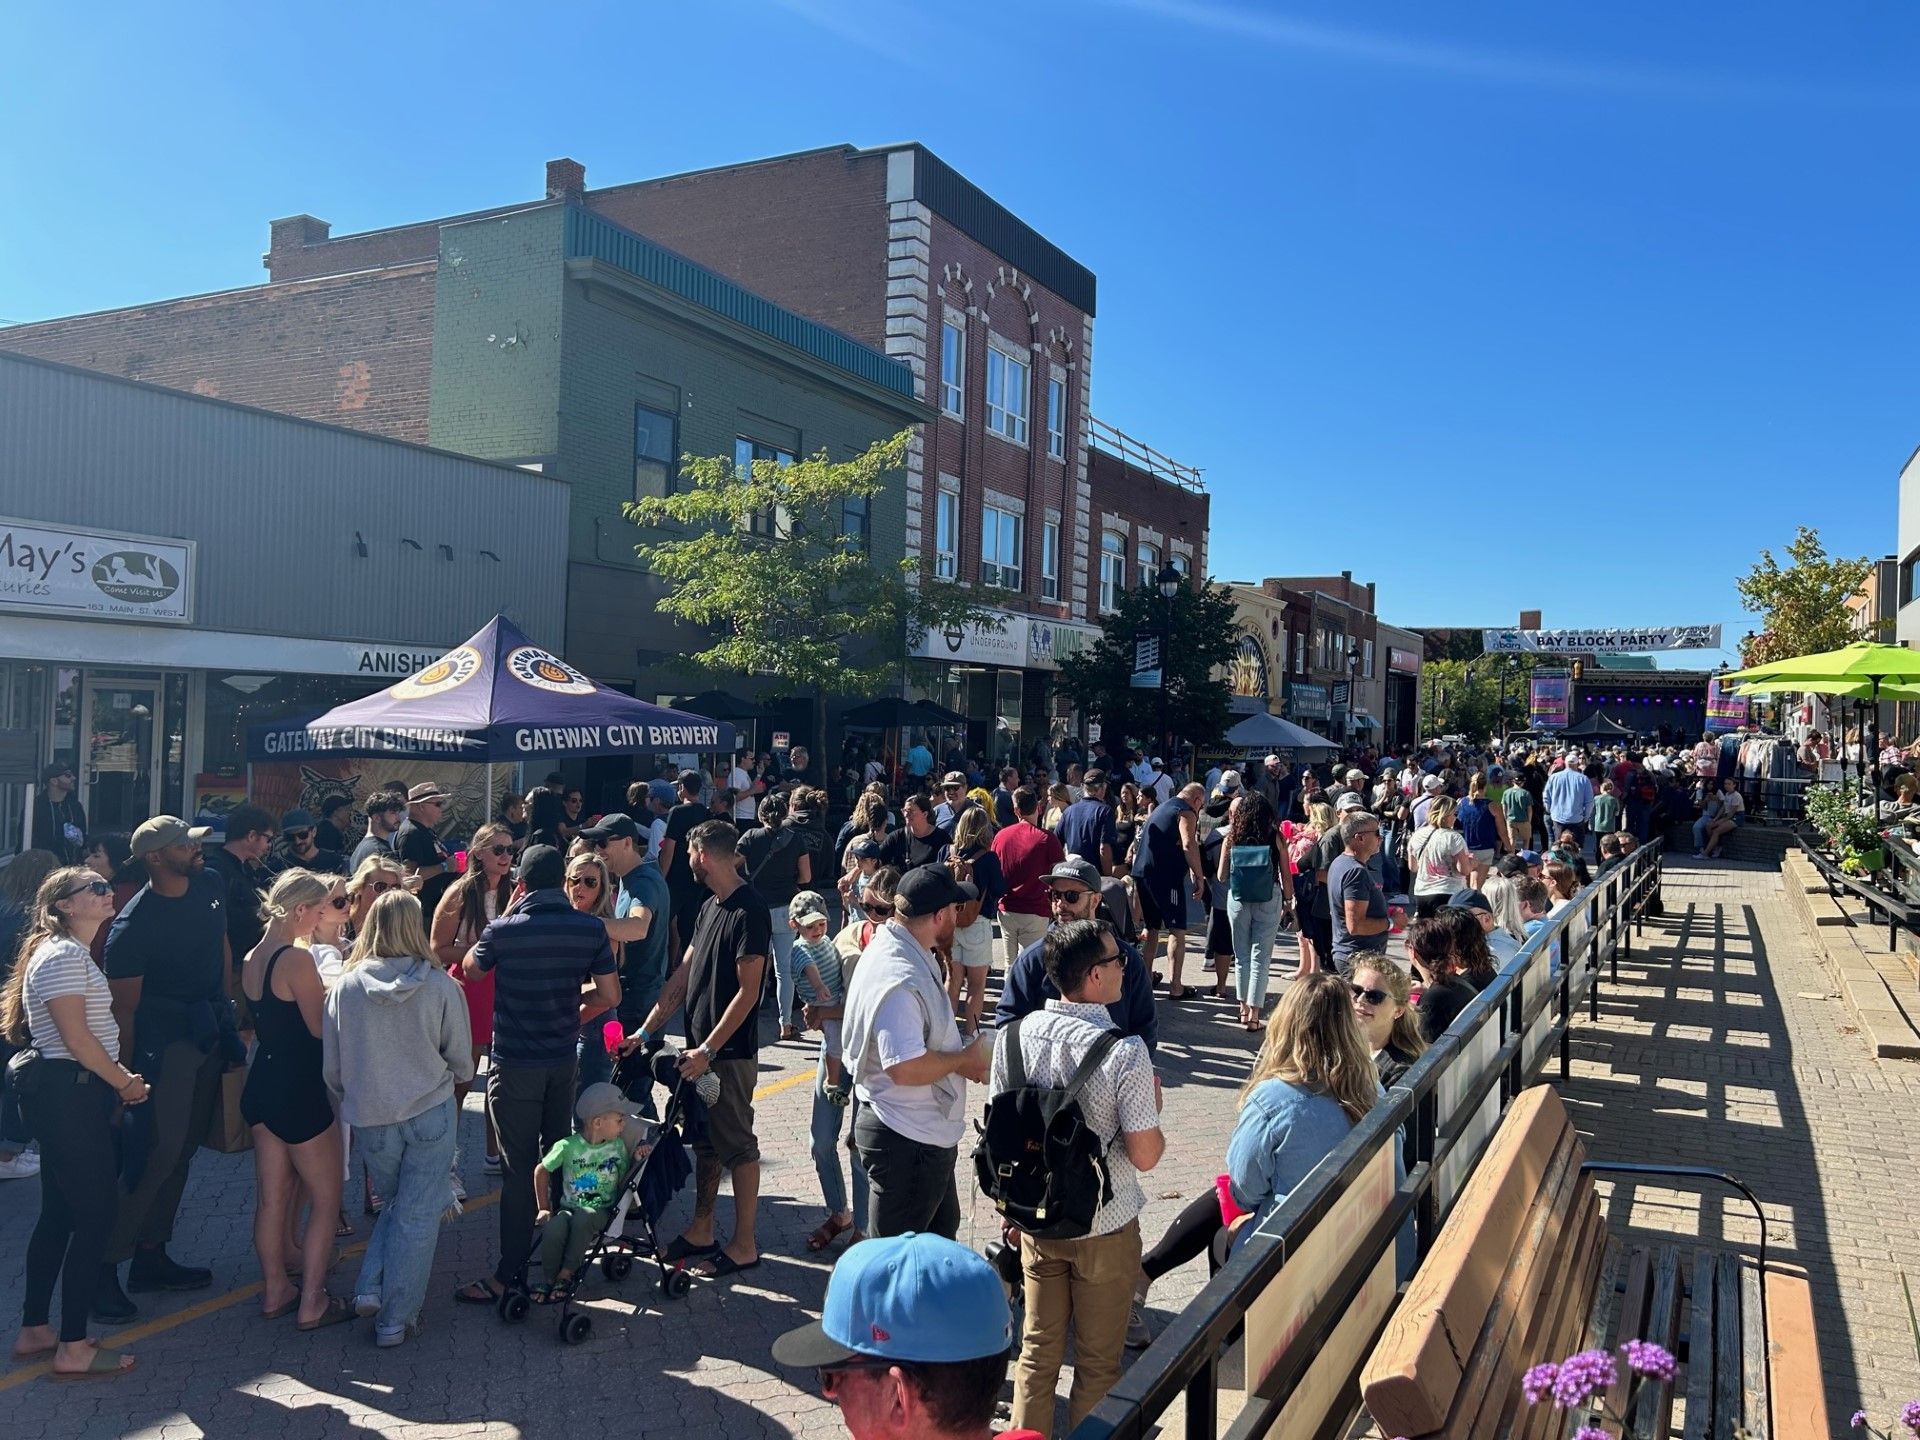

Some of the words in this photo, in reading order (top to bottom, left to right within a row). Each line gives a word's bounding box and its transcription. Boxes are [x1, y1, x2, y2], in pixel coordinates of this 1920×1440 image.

[109, 605, 134, 614] MAIN
[154, 609, 178, 617] WEST
[970, 635, 1018, 650] UNDERGROUND
[1536, 636, 1563, 646] BAY
[1567, 635, 1615, 646] BLOCK
[1620, 634, 1667, 645] PARTY
[513, 650, 549, 679] GATEWAY
[264, 728, 336, 753] GATEWAY
[341, 726, 377, 750] CITY
[383, 727, 467, 752] BREWERY
[515, 726, 600, 751] GATEWAY
[606, 725, 644, 747] CITY
[650, 725, 719, 746] BREWERY
